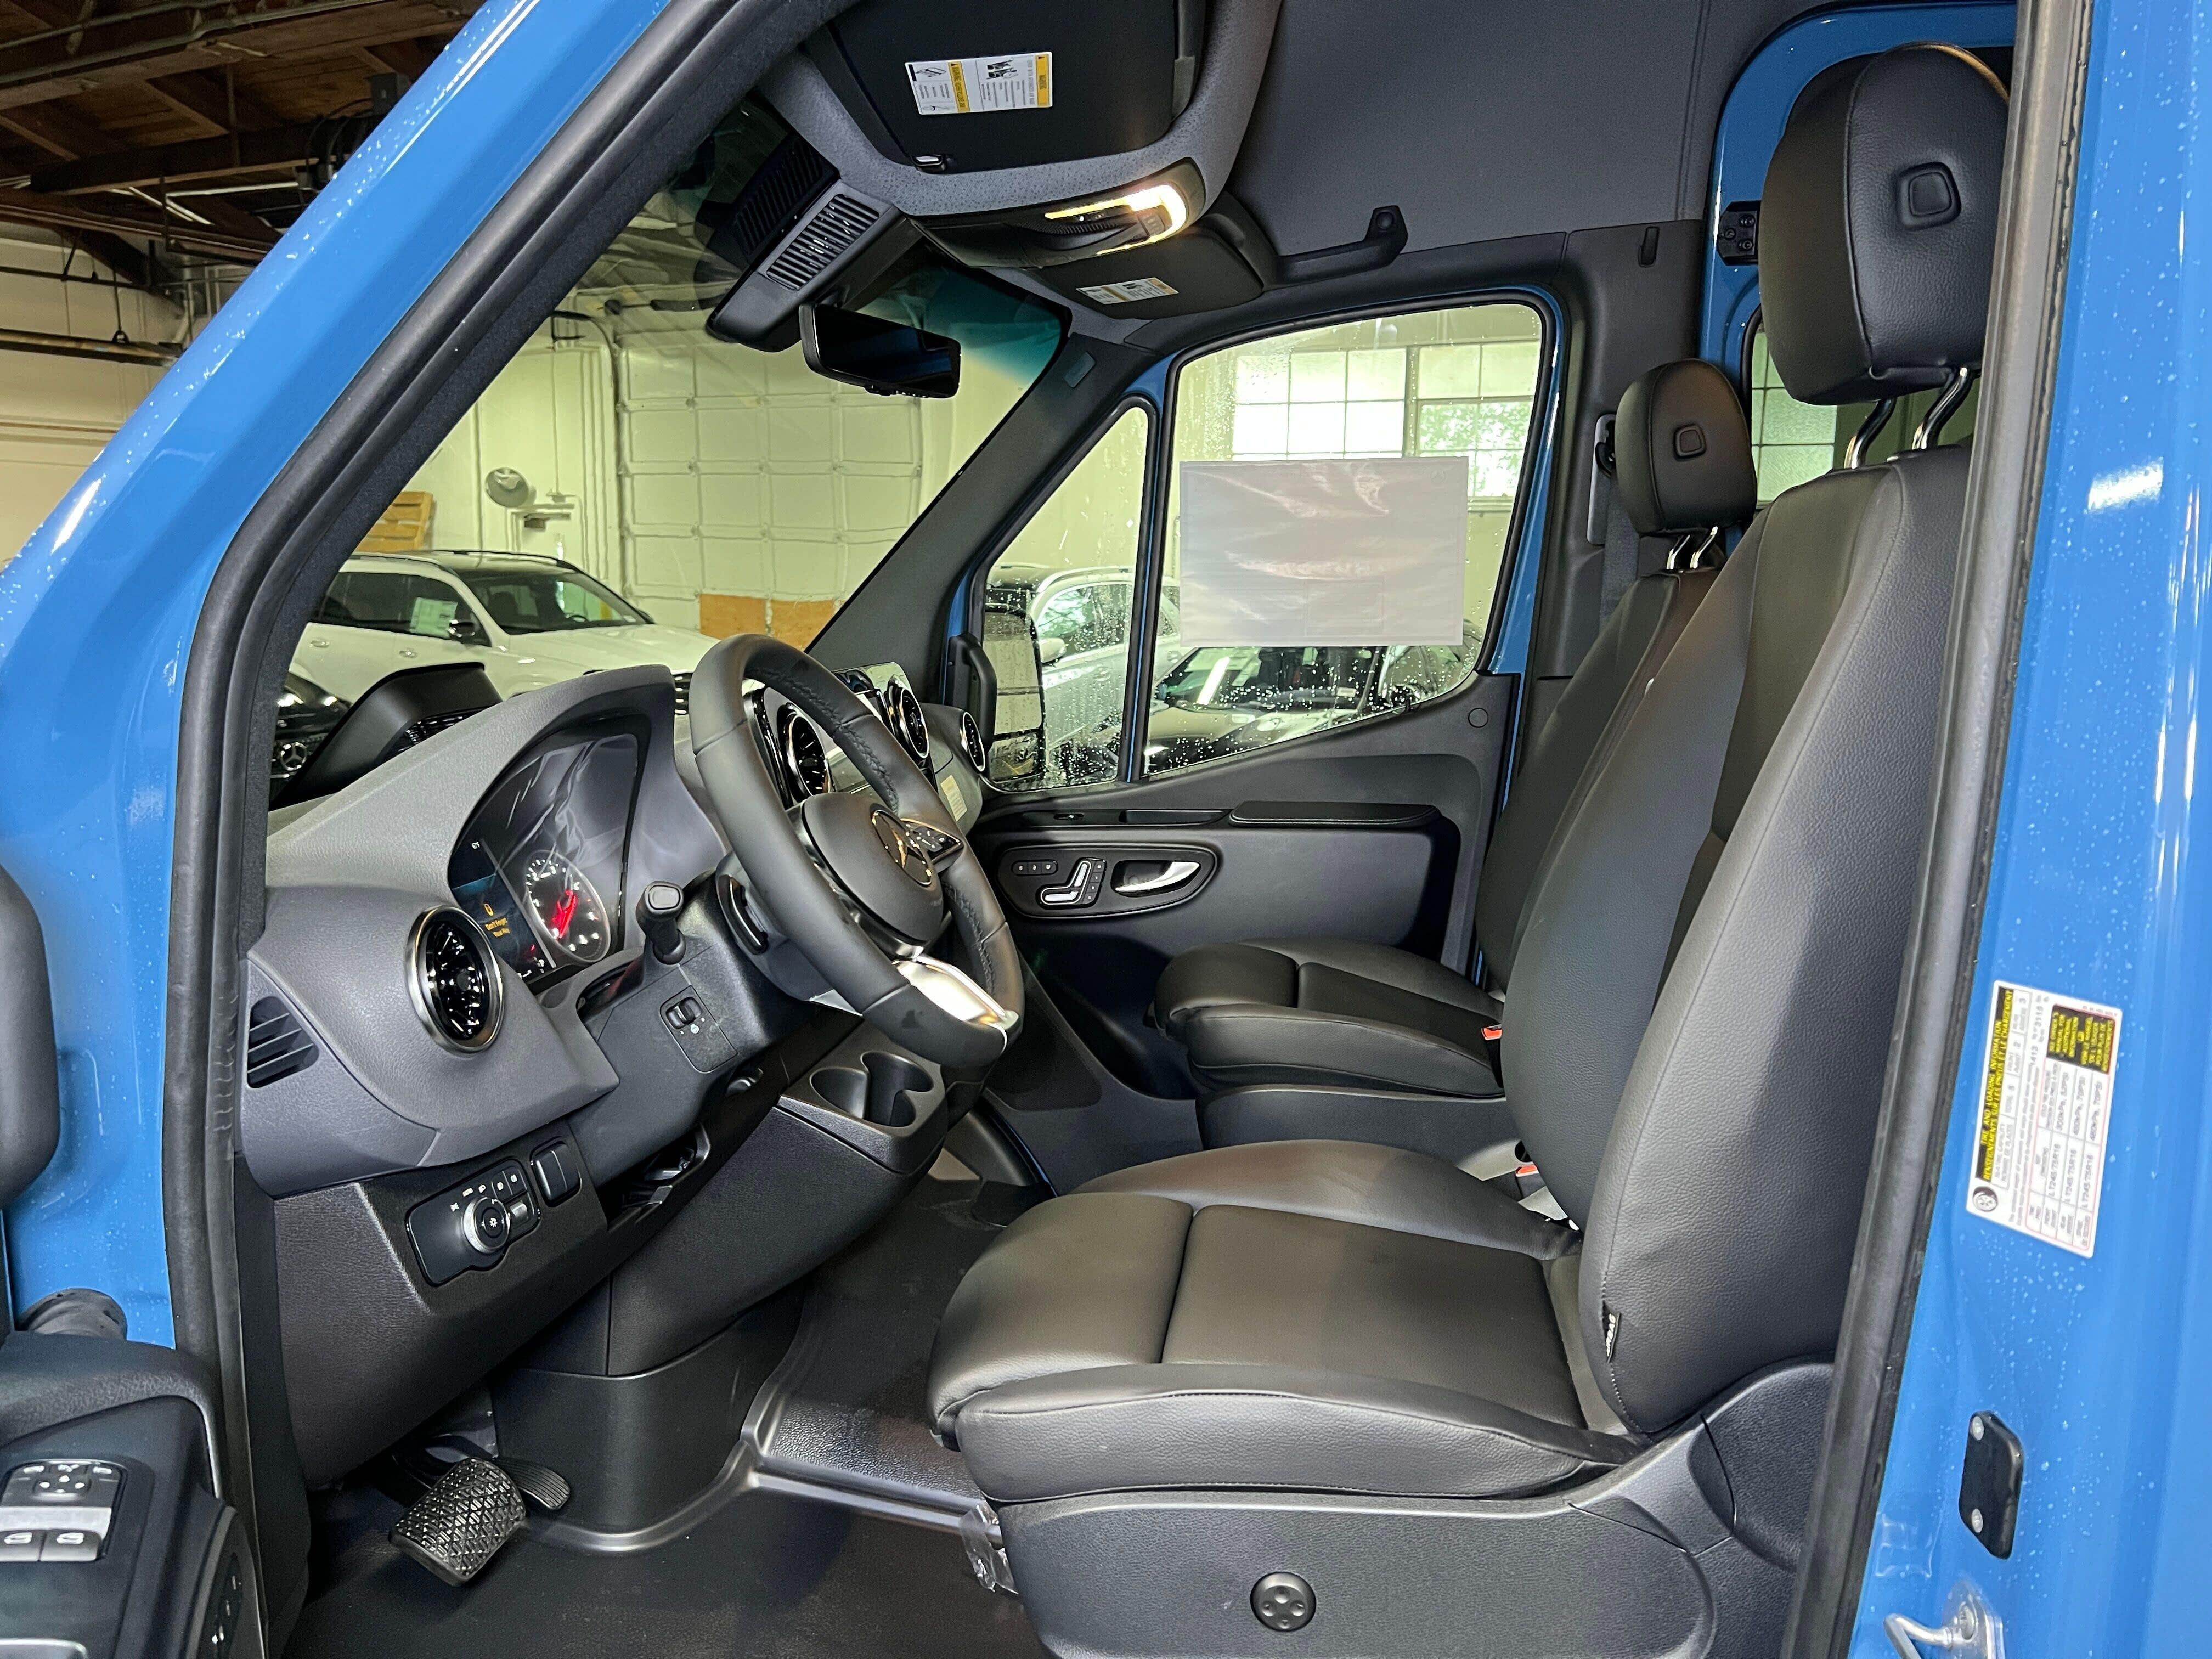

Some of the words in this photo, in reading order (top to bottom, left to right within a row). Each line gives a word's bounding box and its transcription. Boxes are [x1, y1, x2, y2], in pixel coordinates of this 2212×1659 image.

[2000, 990, 2012, 1037] CHARGEMENT
[1989, 1020, 2001, 1069] INFORMATION
[1985, 1073, 1995, 1105] LOADING
